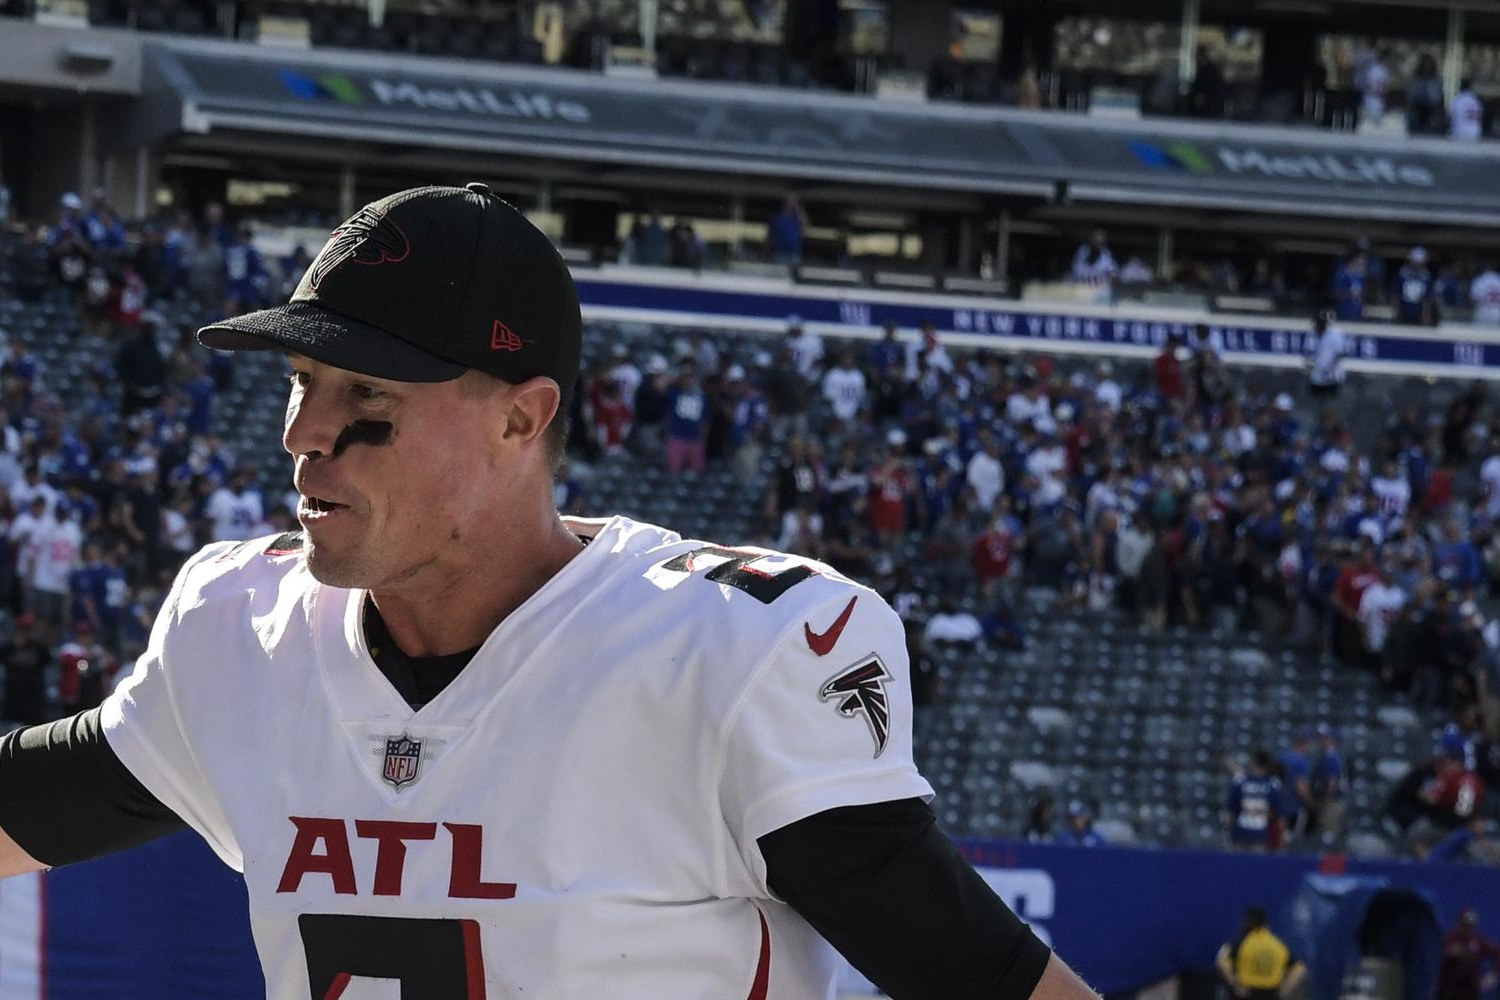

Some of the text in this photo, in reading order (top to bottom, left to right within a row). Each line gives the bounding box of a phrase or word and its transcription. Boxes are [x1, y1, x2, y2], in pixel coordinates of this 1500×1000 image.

[371, 79, 591, 123] MetLife
[1217, 148, 1436, 186] MetLife
[953, 309, 1378, 359] NEW YORK FOOTLL GIATS
[276, 816, 517, 899] ATL
